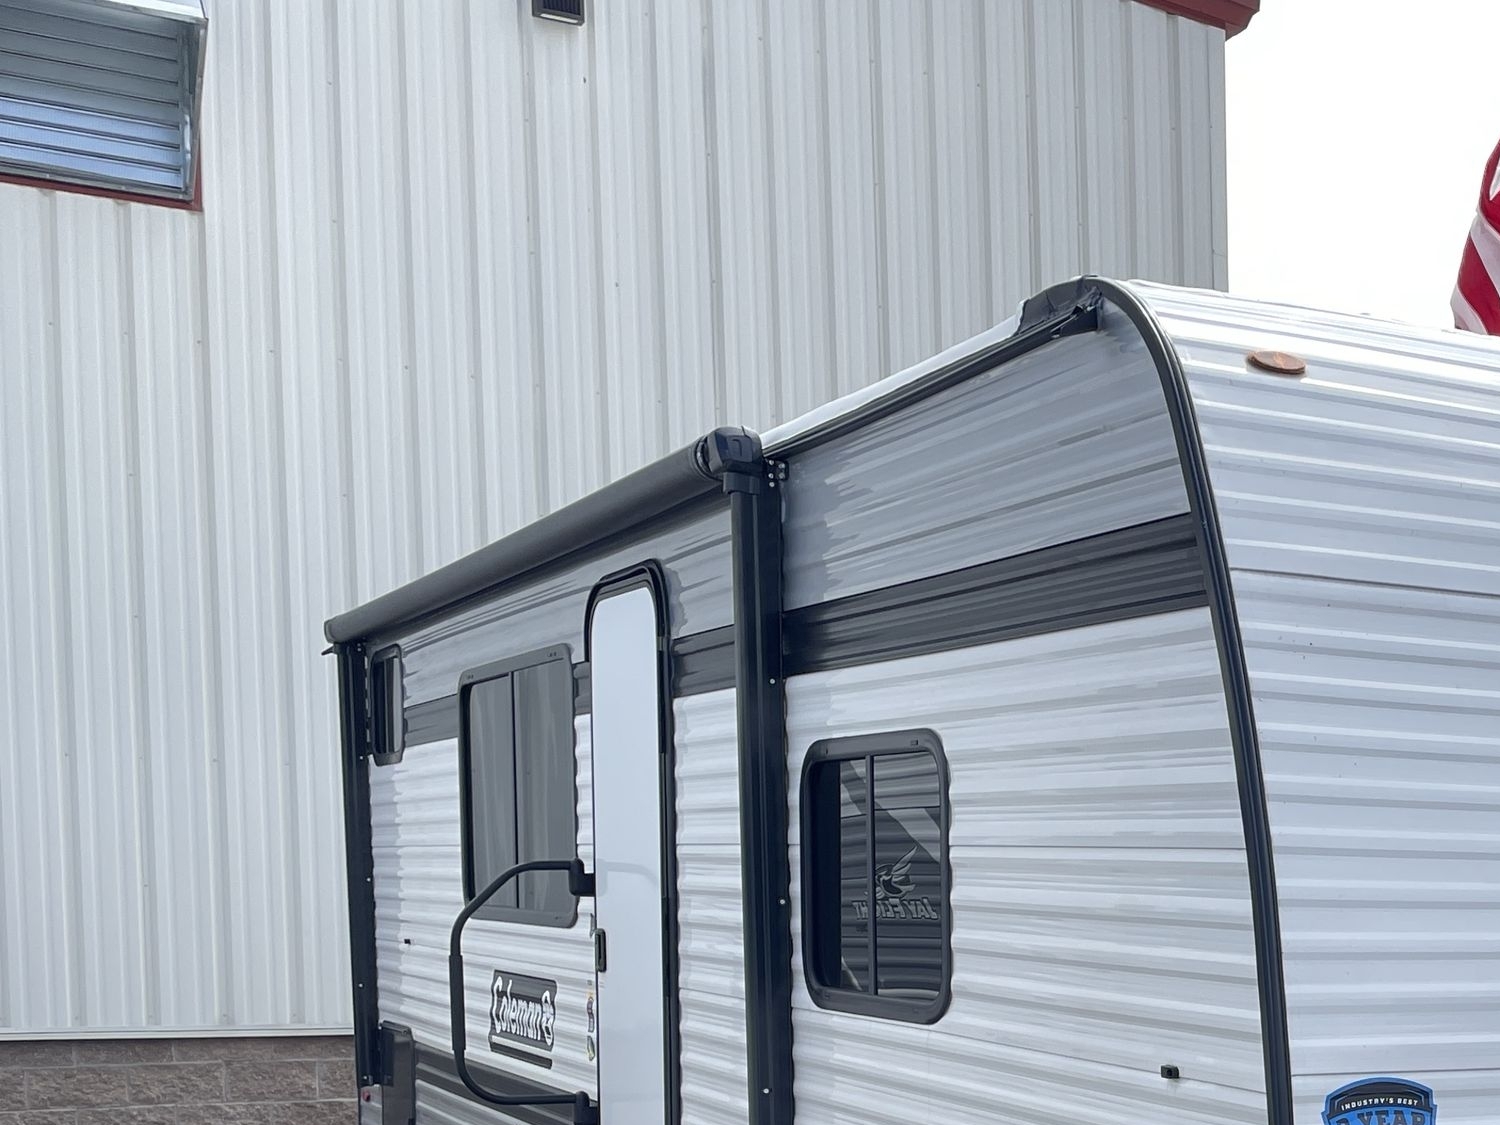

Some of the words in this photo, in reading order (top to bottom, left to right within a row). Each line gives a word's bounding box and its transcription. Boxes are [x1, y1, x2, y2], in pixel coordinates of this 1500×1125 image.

[492, 976, 541, 1041] Coleman
[1341, 1097, 1394, 1111] INDUSTRY'S
[1397, 1097, 1418, 1106] BEST
